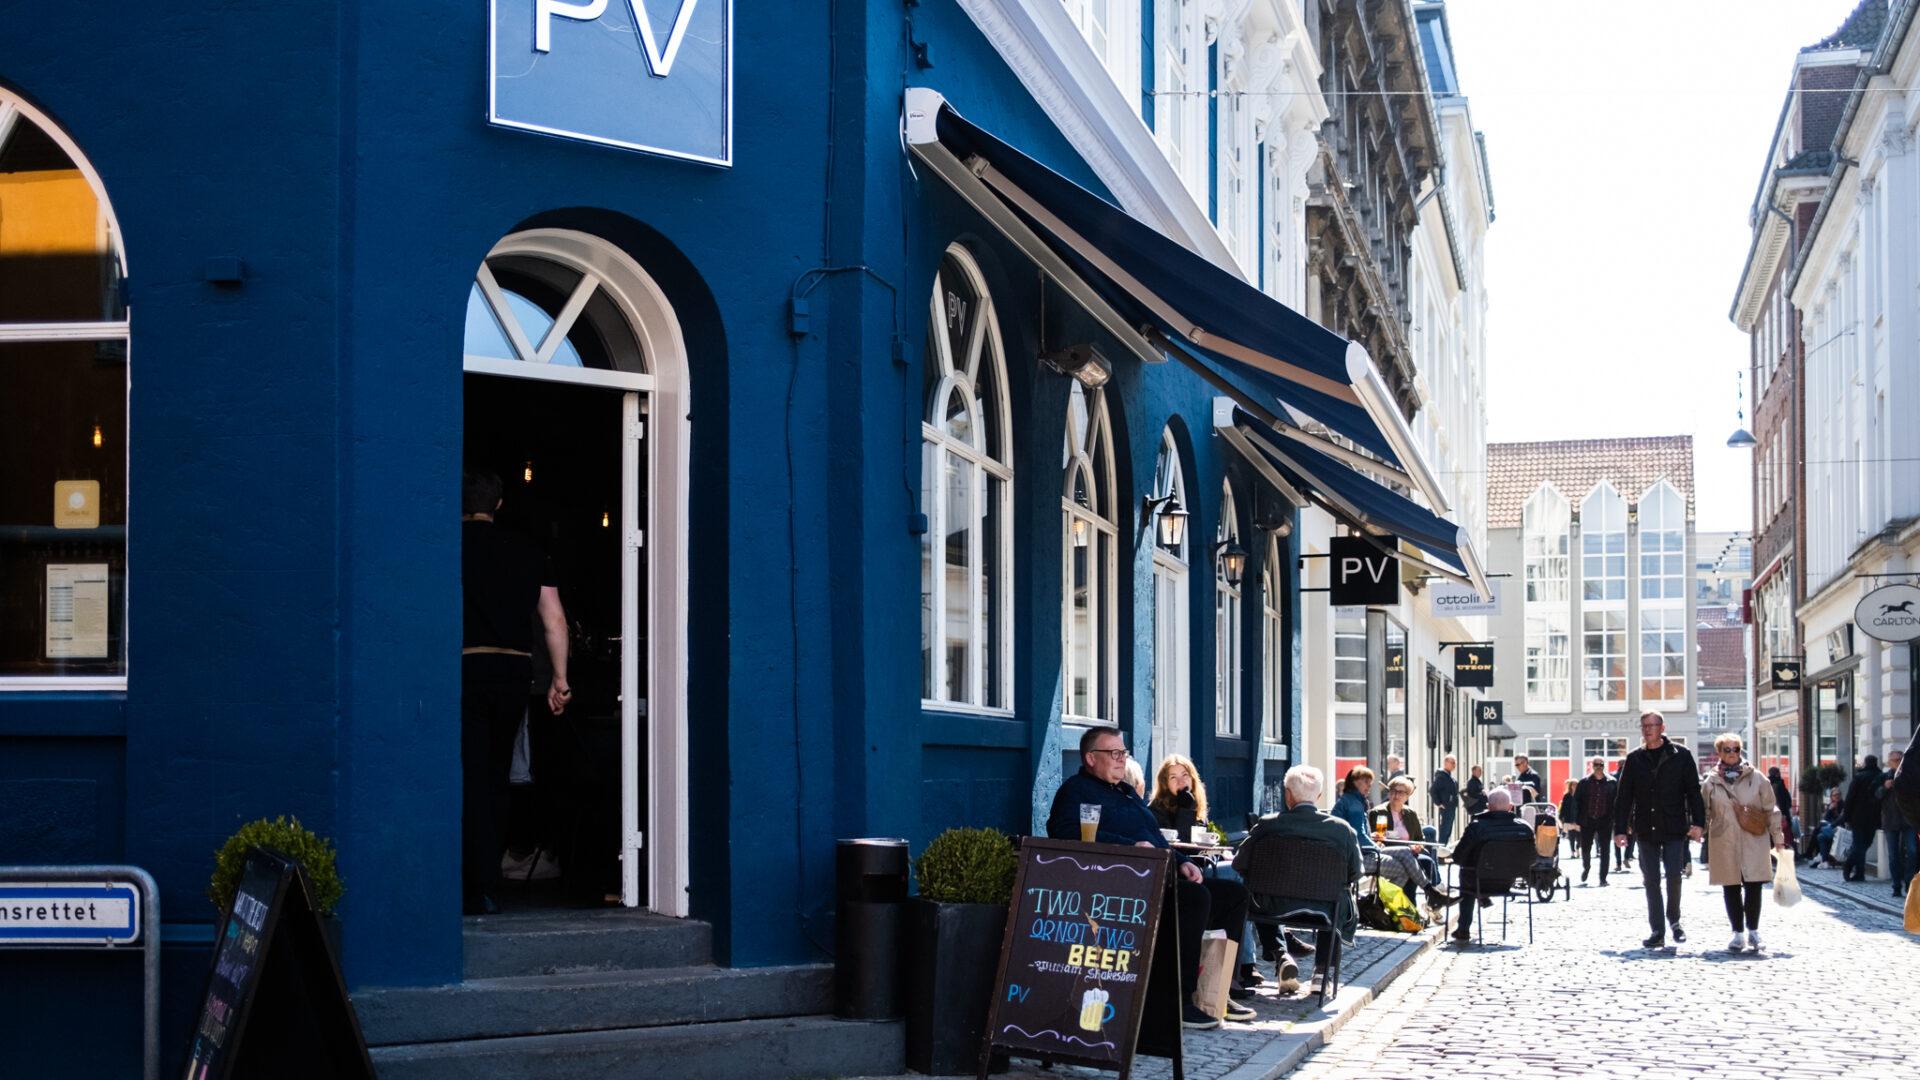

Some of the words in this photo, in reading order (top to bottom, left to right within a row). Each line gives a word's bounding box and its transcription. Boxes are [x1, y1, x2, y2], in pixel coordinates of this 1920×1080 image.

[948, 291, 967, 337] PV
[1341, 556, 1389, 584] PV
[1436, 594, 1496, 605] ottolie
[1872, 617, 1920, 627] CARLTON
[1008, 984, 1030, 1003] PV
